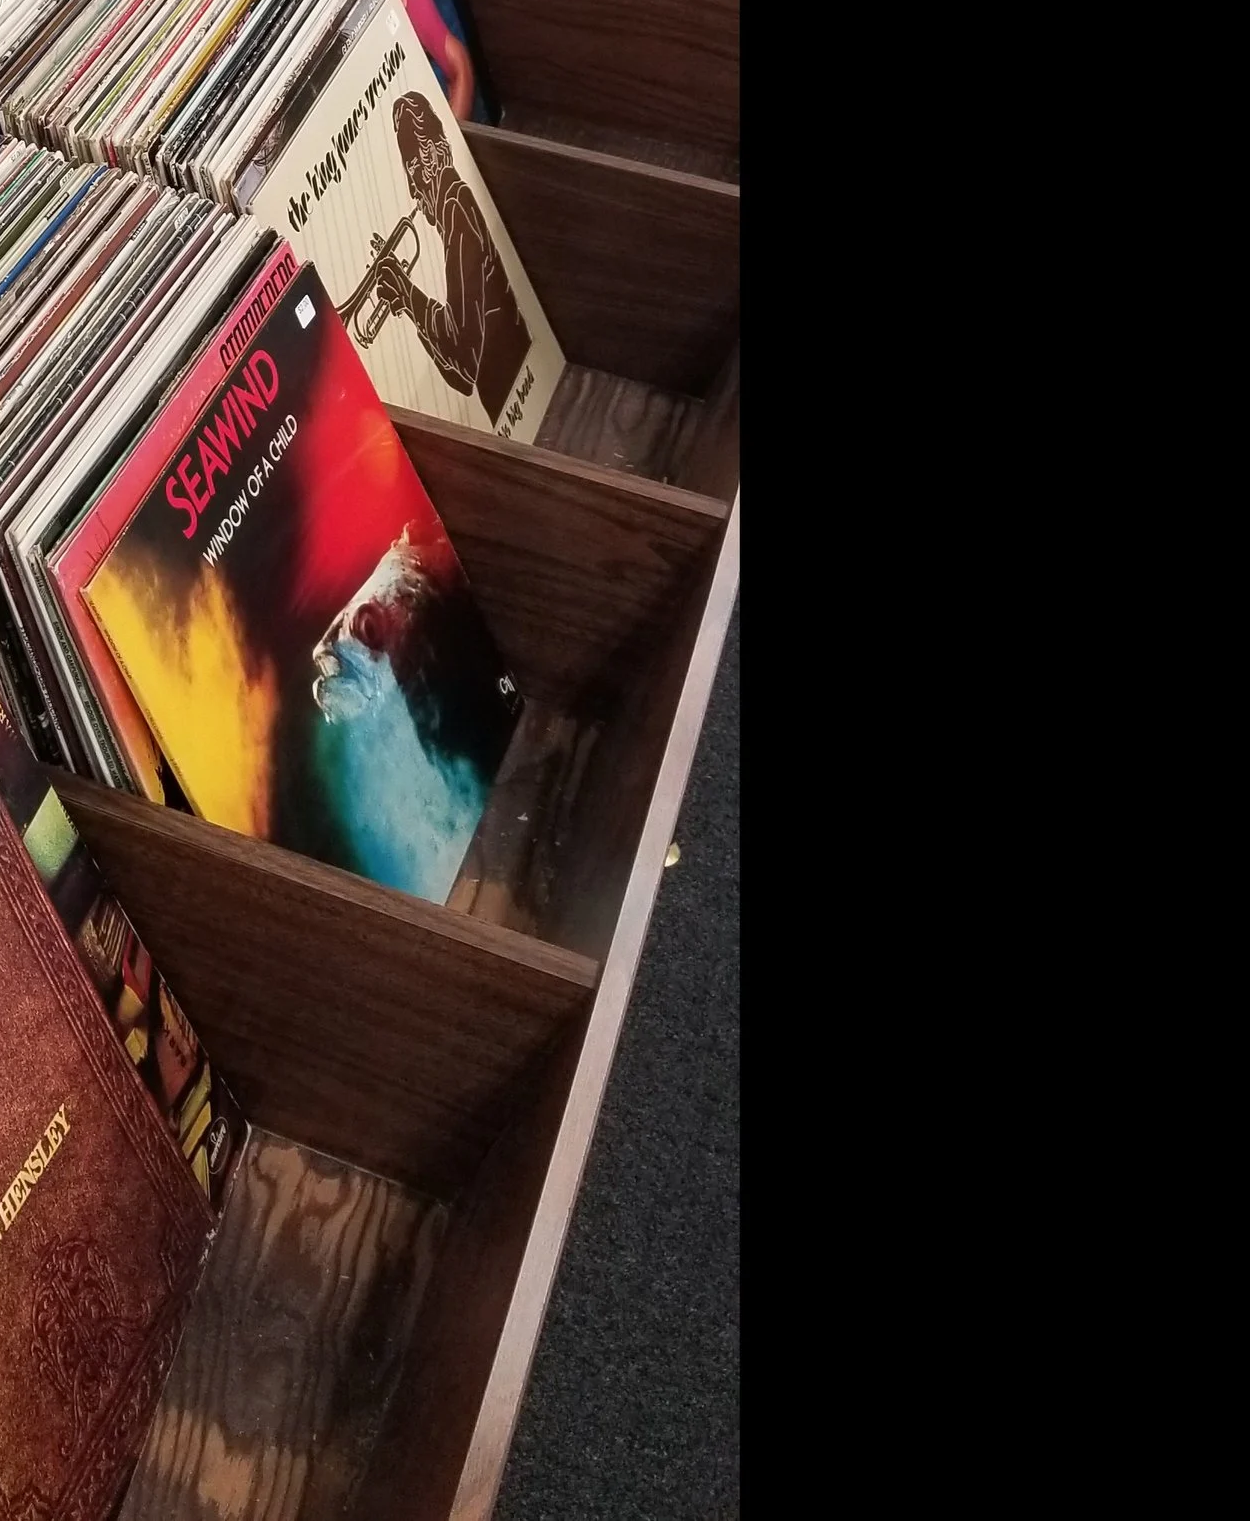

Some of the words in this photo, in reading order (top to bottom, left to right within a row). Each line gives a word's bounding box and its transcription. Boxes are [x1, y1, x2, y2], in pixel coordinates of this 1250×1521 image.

[288, 186, 314, 234] the
[305, 153, 343, 211] king
[364, 40, 407, 112] version
[165, 348, 280, 539] SEAWIND
[264, 460, 276, 479] A
[269, 413, 299, 466] CHILD
[247, 470, 266, 498] OF
[202, 492, 249, 569] WINDOW
